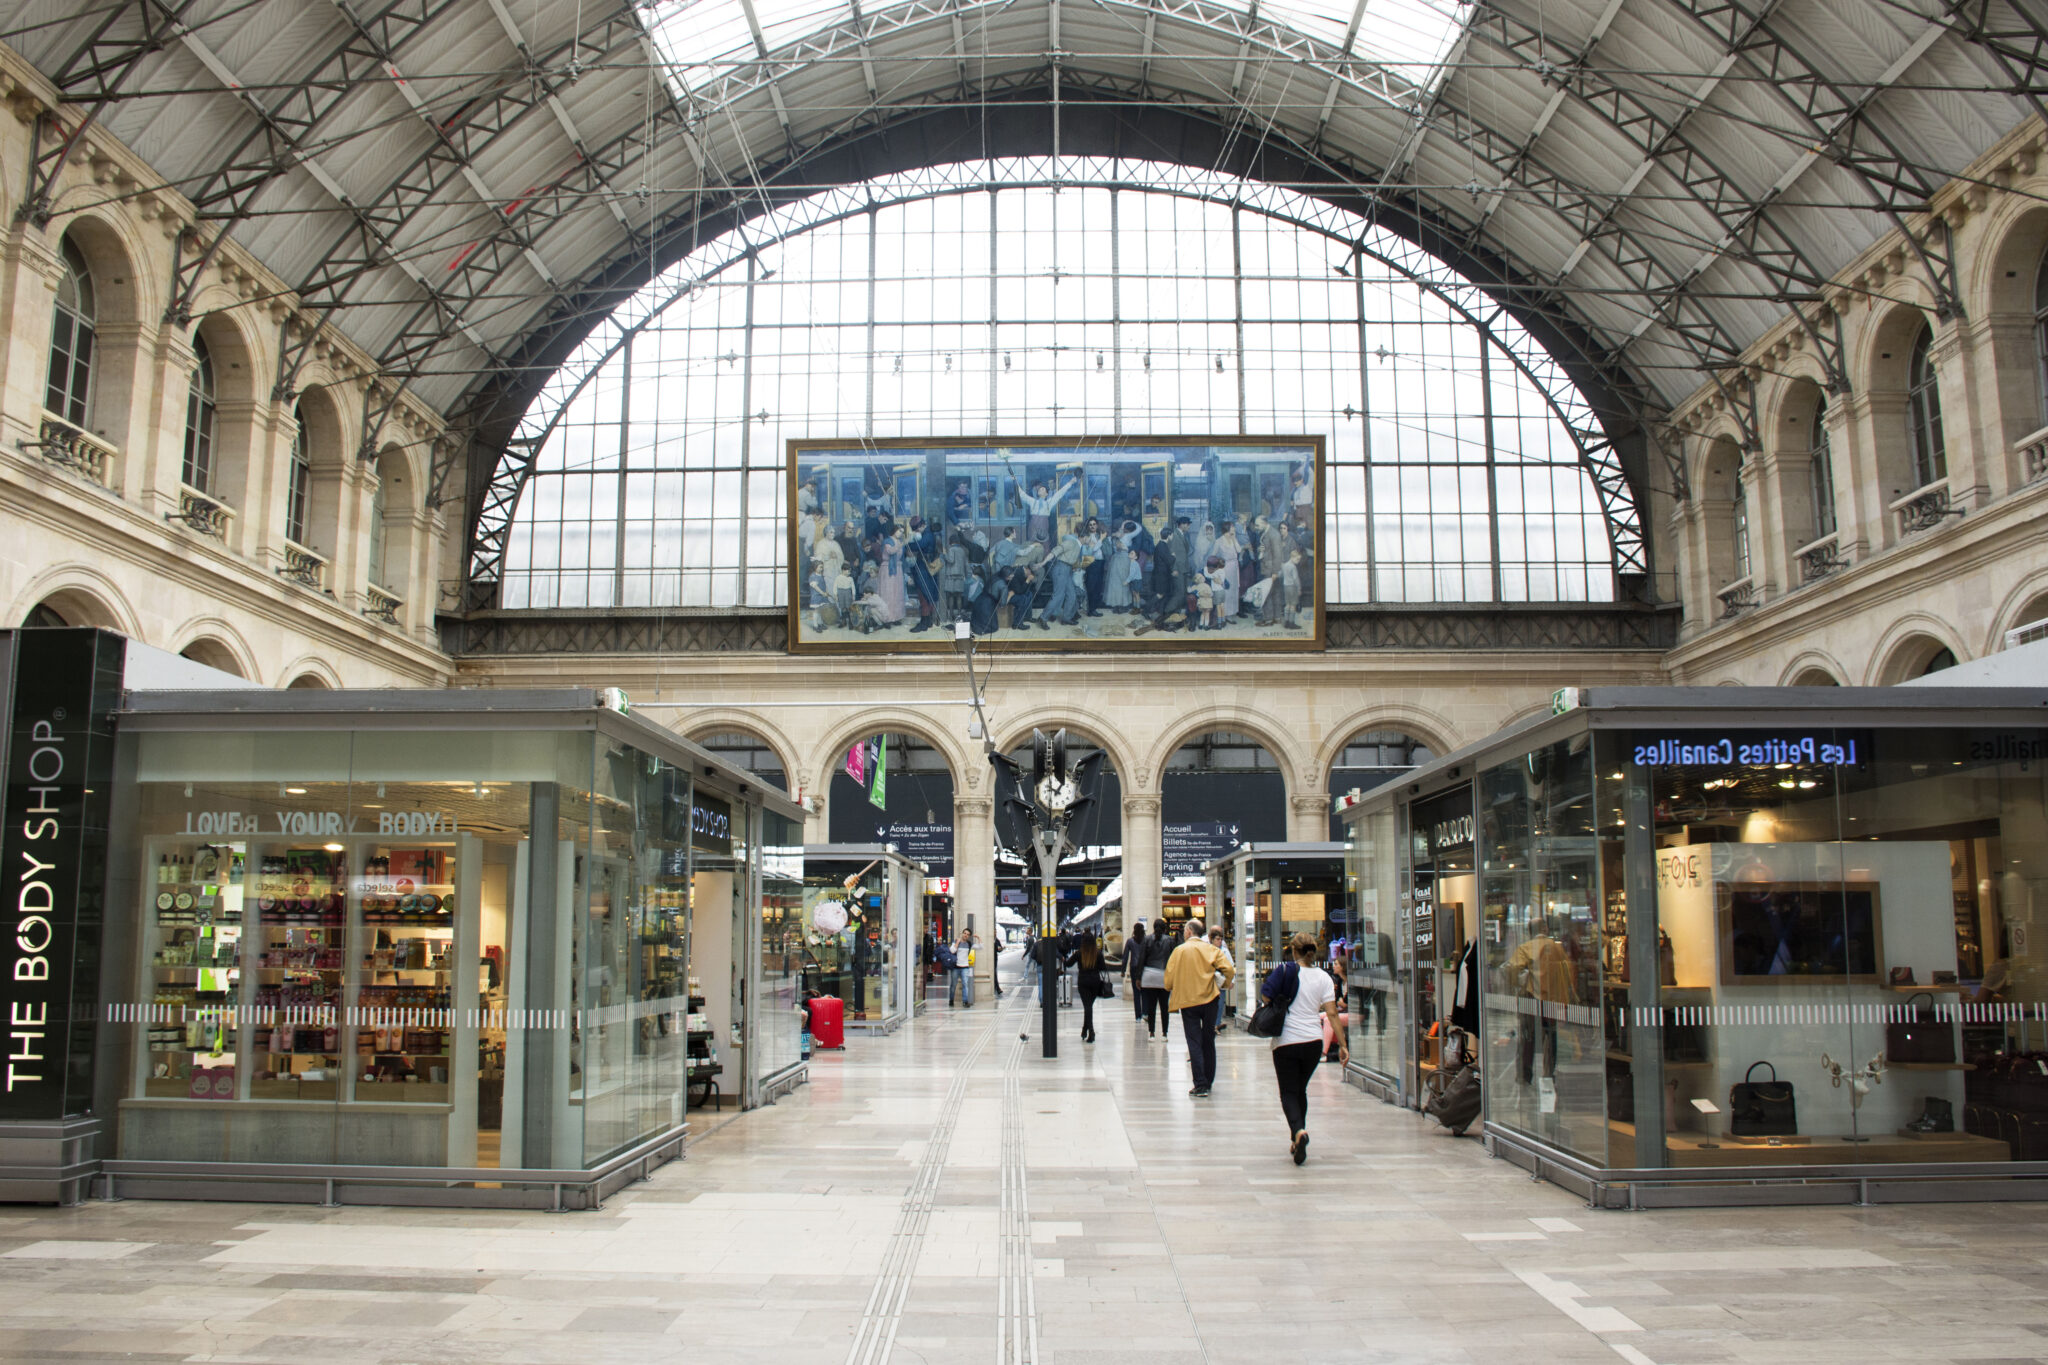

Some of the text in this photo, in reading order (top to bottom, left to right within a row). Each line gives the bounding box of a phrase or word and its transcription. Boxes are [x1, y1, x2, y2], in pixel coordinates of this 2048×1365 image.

[185, 811, 441, 836] LOVE YOUR BODY
[889, 825, 912, 833] Accès
[929, 825, 952, 833] trains
[1163, 825, 1192, 833] Accueil
[1163, 838, 1187, 846] Billets
[1163, 863, 1194, 872] Parking
[7, 720, 65, 1092] THE BODY SHOP
